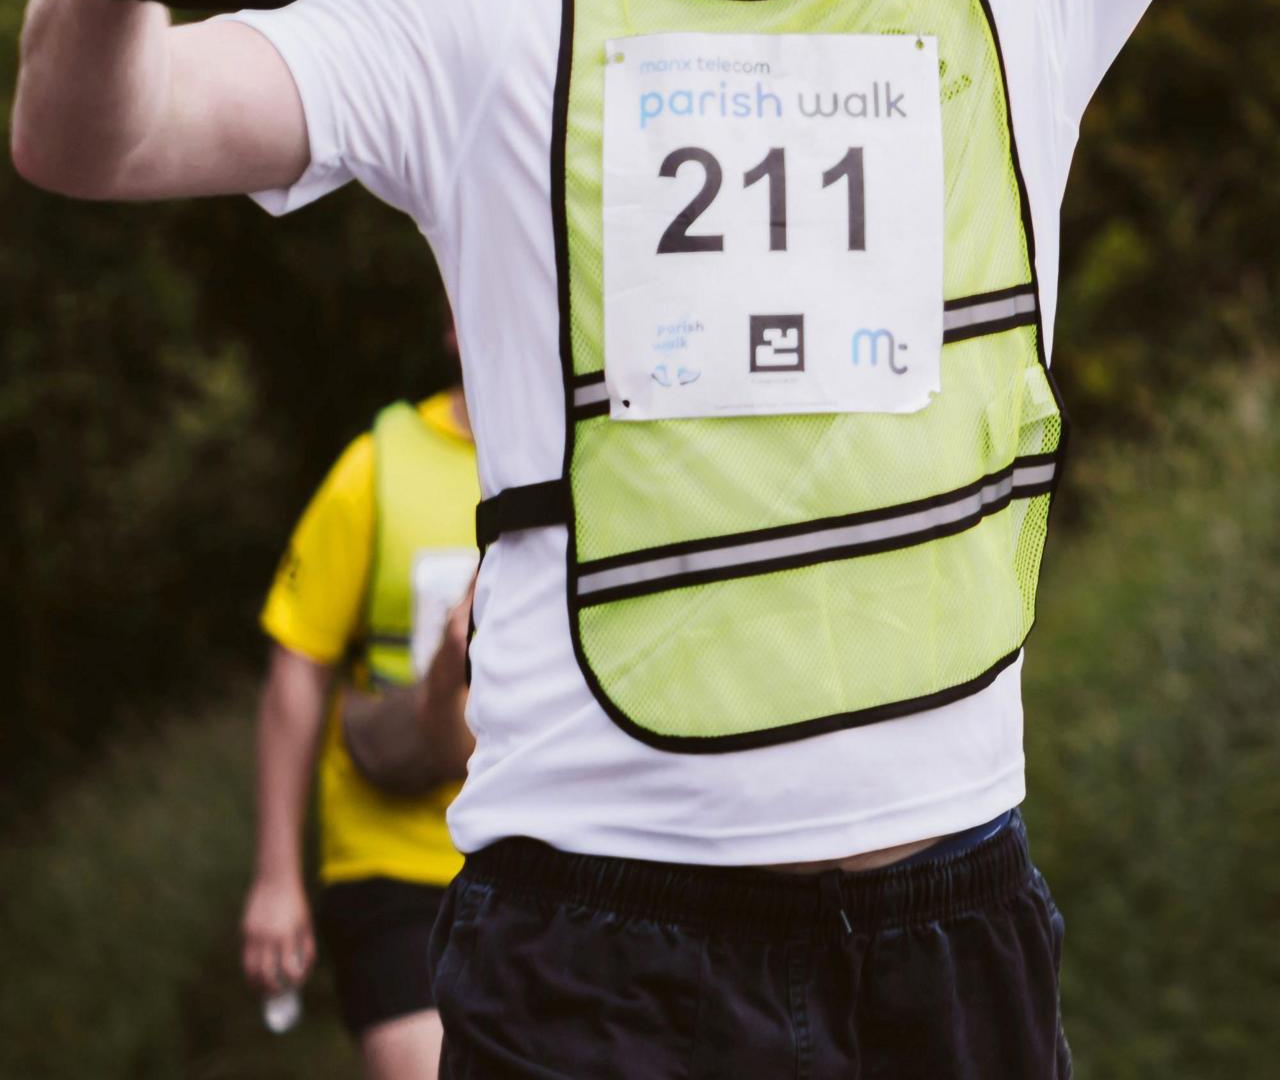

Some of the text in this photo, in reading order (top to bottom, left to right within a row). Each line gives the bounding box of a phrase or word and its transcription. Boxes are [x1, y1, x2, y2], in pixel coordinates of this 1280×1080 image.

[640, 57, 771, 75] manx telecom
[639, 80, 907, 129] parish walk
[656, 146, 867, 255] 211
